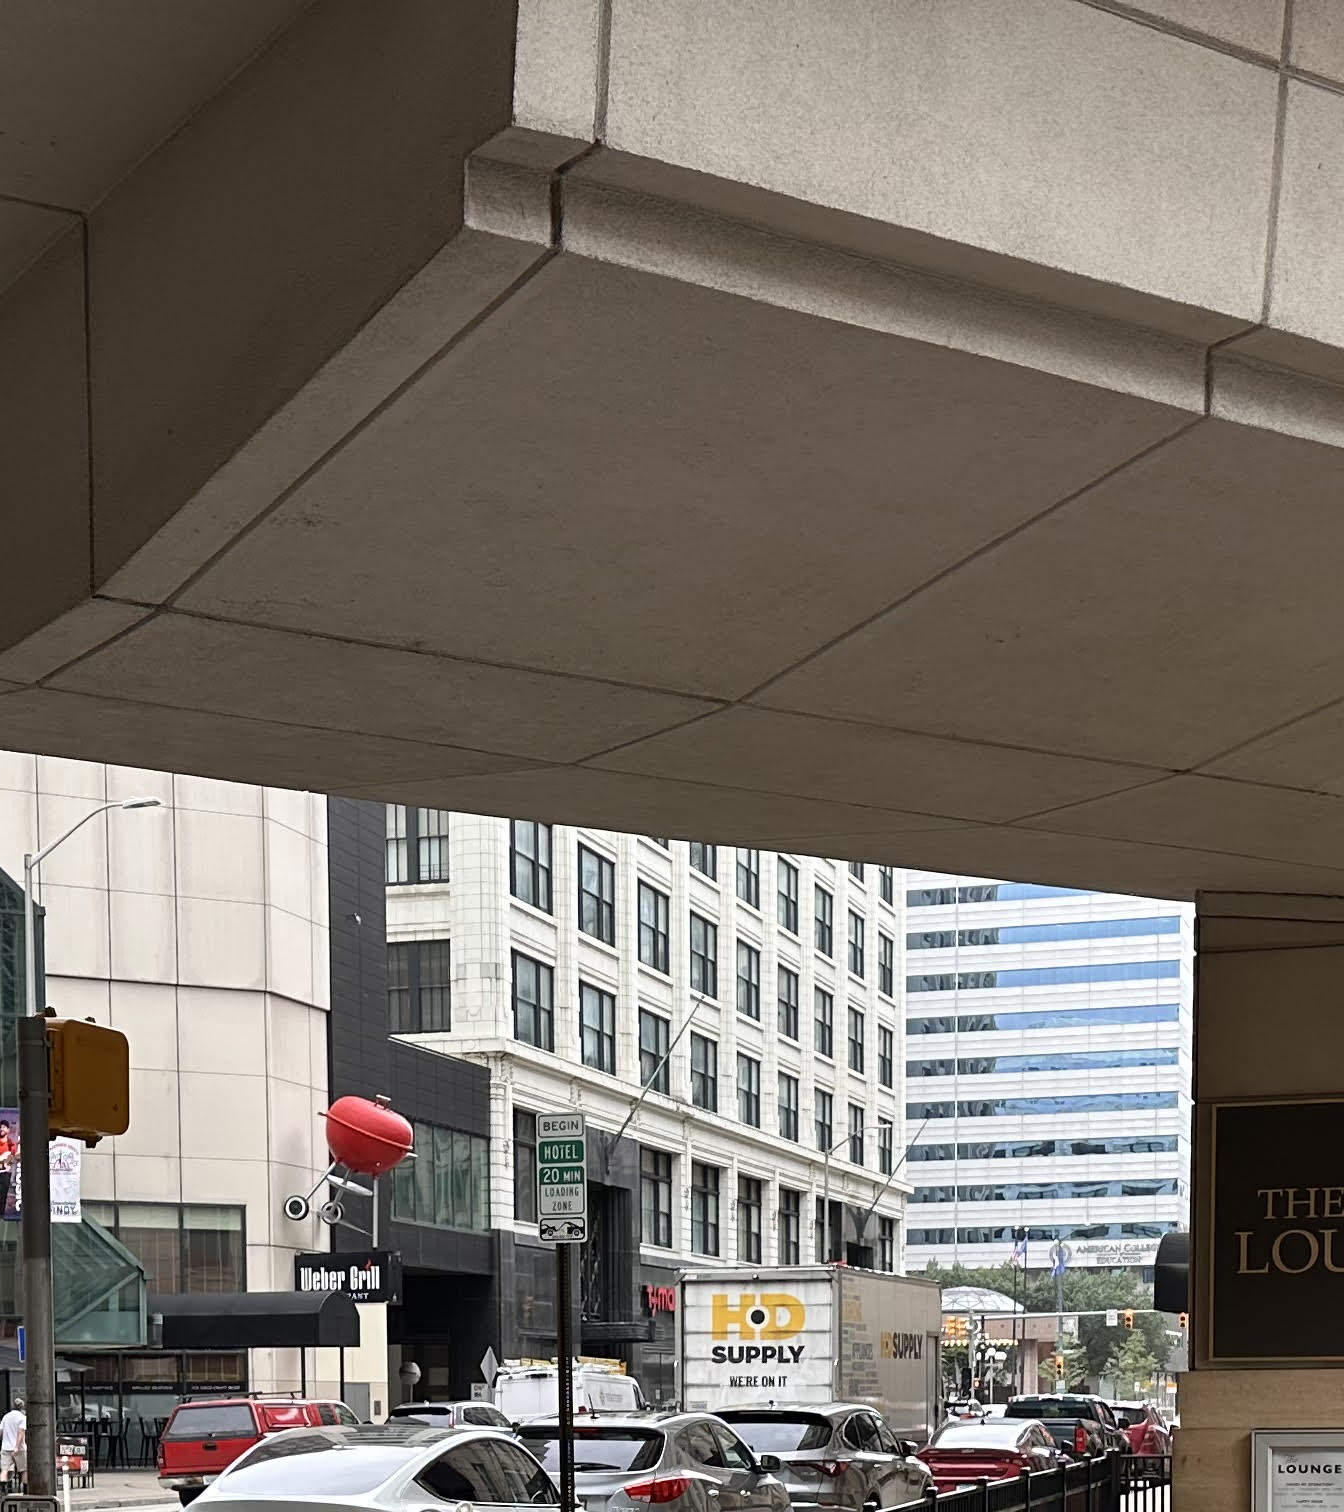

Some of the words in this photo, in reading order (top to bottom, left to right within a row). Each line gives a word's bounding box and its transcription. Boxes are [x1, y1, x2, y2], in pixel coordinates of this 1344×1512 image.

[543, 1121, 579, 1131] BEGIN
[544, 1144, 578, 1160] HOTEL
[543, 1168, 560, 1183] 20
[563, 1170, 581, 1182] MIN
[544, 1186, 579, 1197] LOADING
[552, 1201, 572, 1212] ZONE
[300, 1267, 346, 1291] Weber
[350, 1261, 380, 1290] Grill
[712, 1293, 806, 1341] HD
[892, 1332, 923, 1360] SUPPLY
[711, 1345, 805, 1364] SUPPLY
[761, 1375, 775, 1388] ON
[778, 1375, 788, 1388] IT
[1277, 1464, 1343, 1474] LOUNGE
